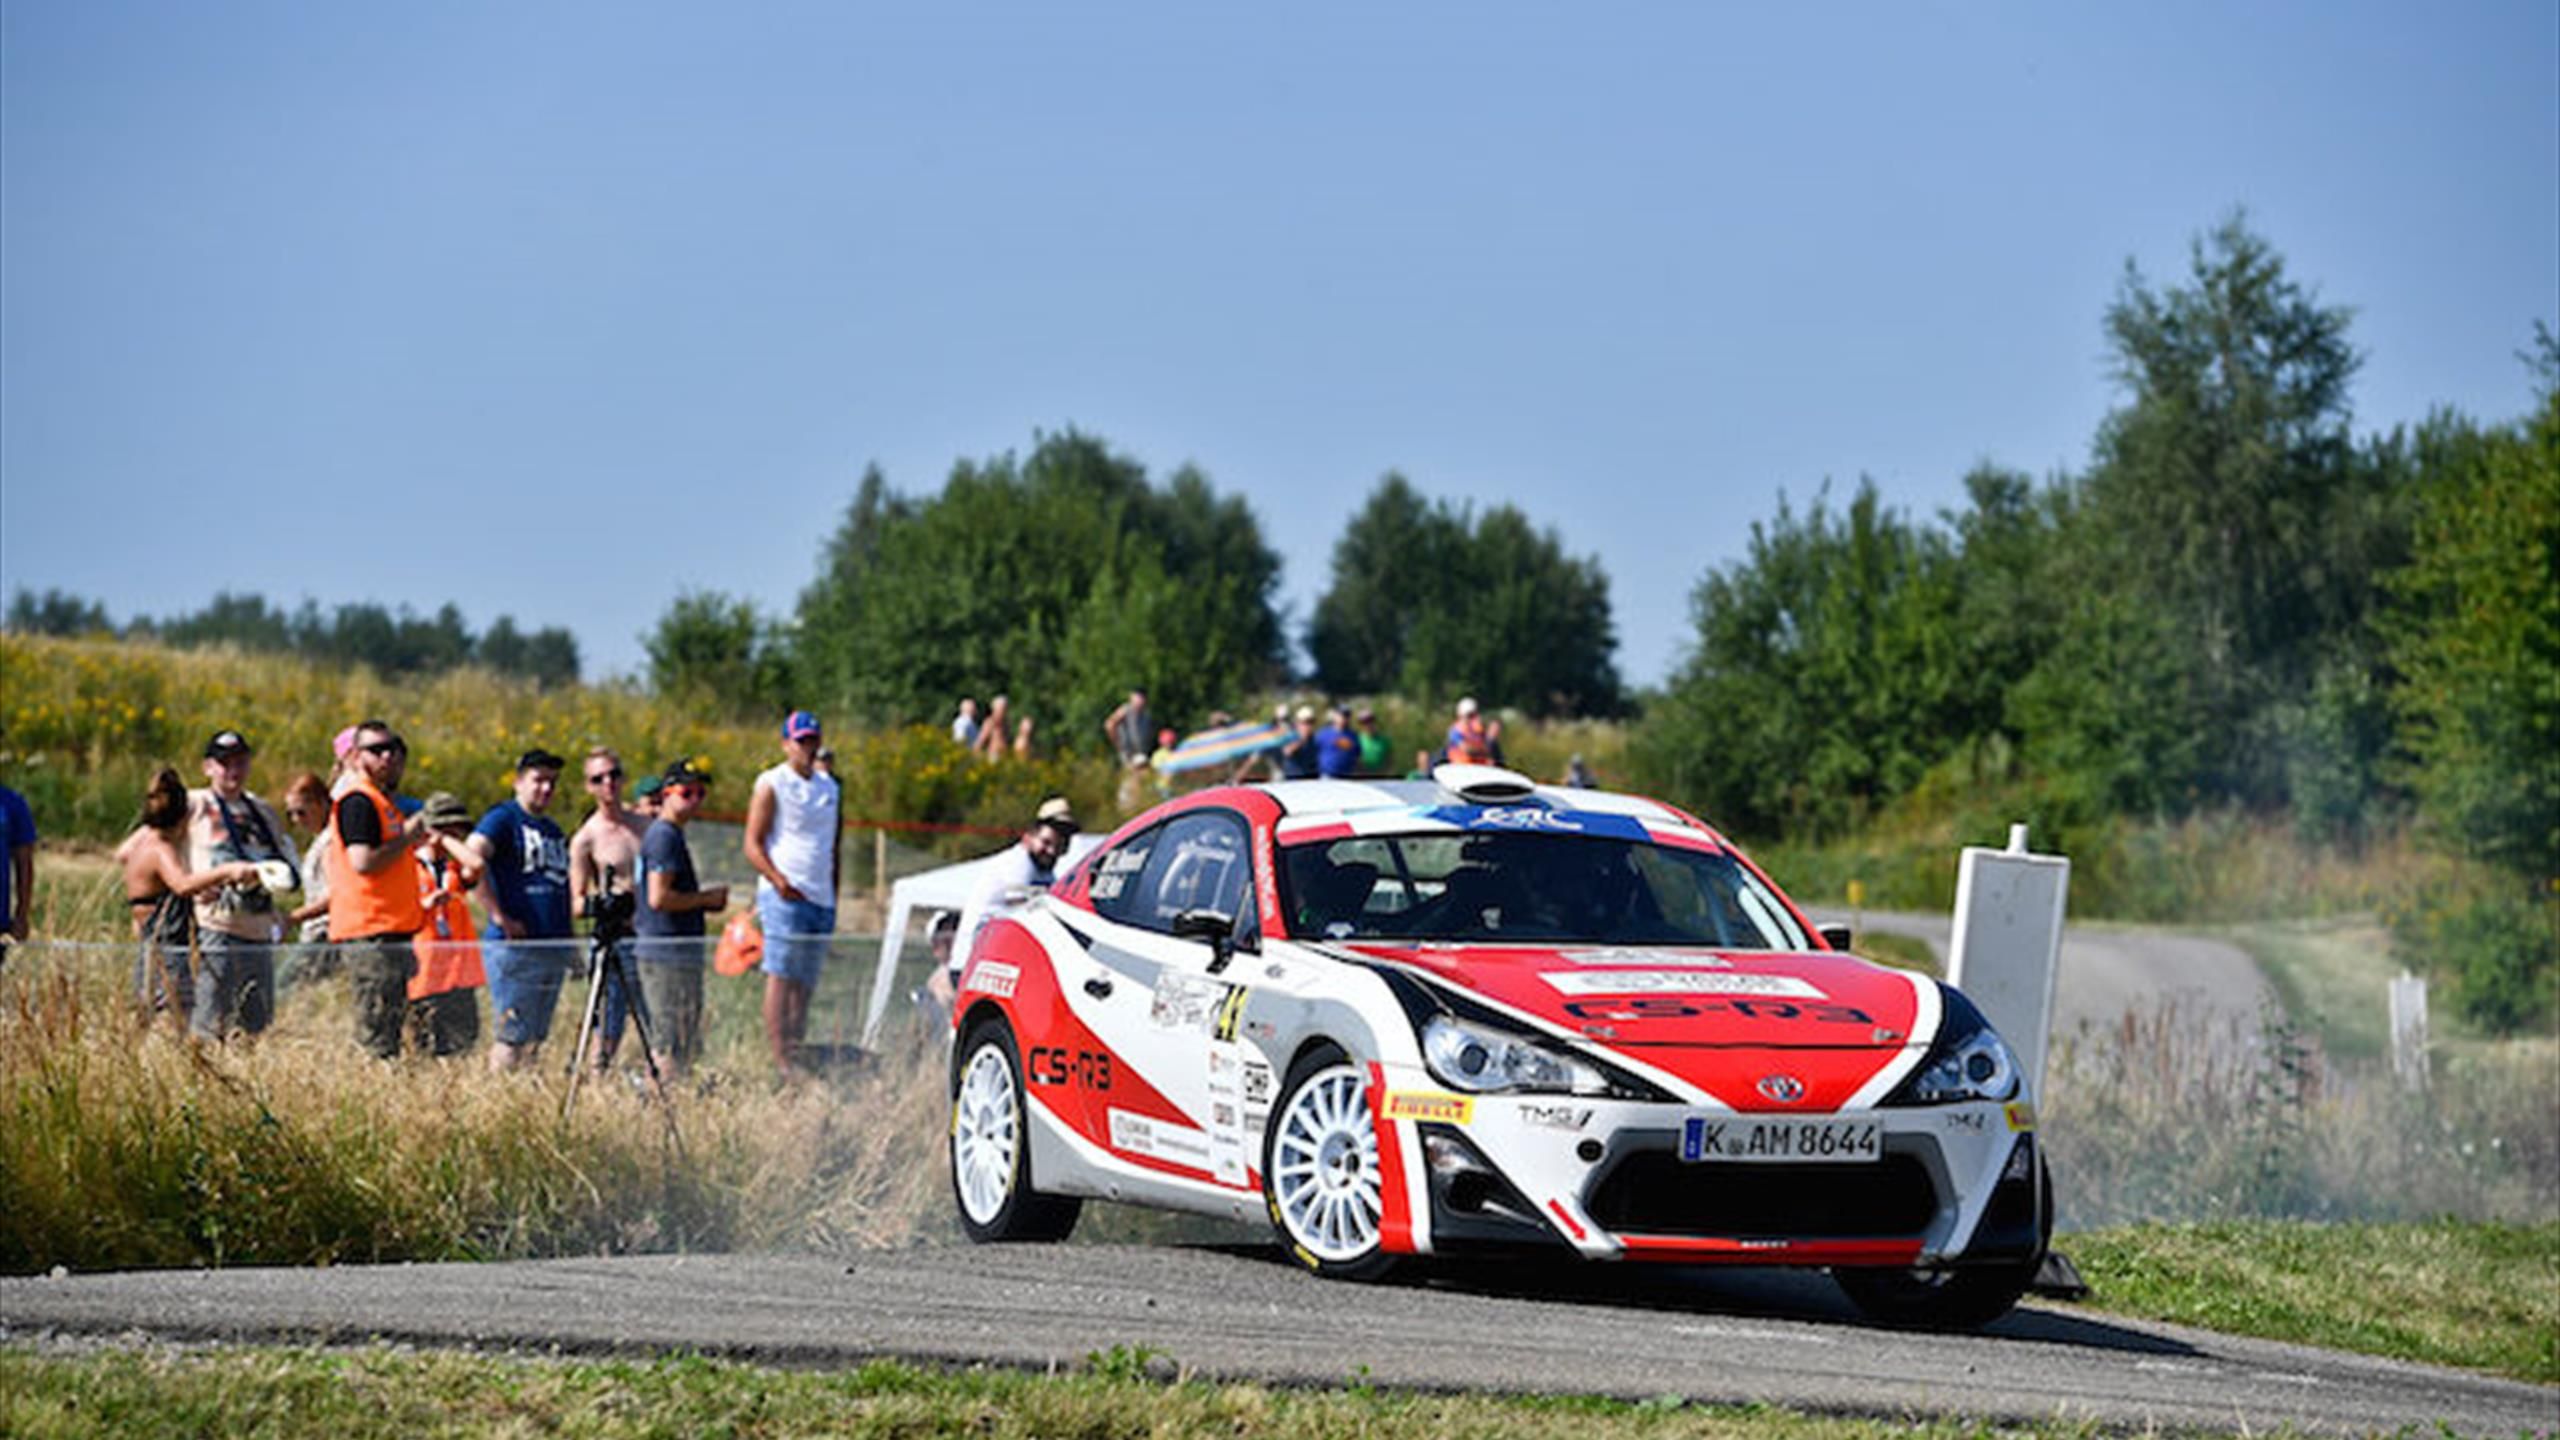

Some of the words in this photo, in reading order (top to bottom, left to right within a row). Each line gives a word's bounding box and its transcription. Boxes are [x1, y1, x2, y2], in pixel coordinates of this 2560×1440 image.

[1704, 1124, 1726, 1154] K
[1750, 1125, 1791, 1155] AM
[1799, 1125, 1876, 1155] 8644
